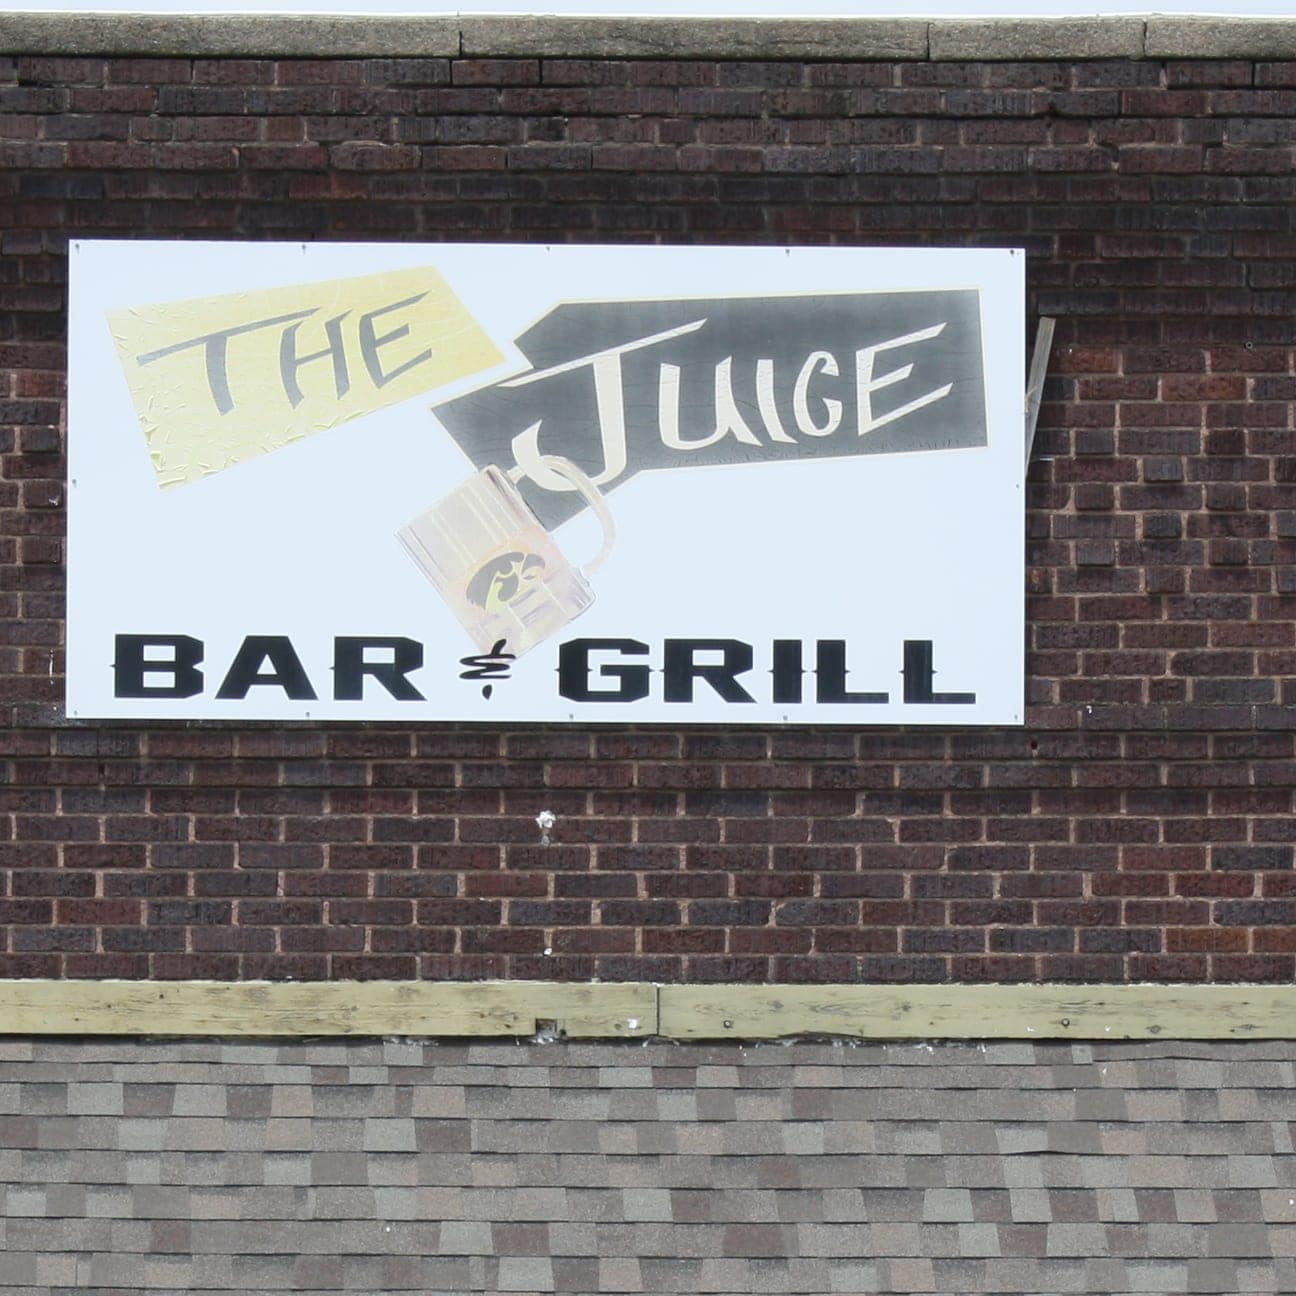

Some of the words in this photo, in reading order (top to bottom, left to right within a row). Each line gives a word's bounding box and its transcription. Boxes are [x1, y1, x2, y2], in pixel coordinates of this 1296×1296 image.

[136, 290, 433, 417] THE
[497, 318, 954, 492] JUICE
[110, 634, 429, 701] BAR
[555, 637, 977, 705] GRILL
